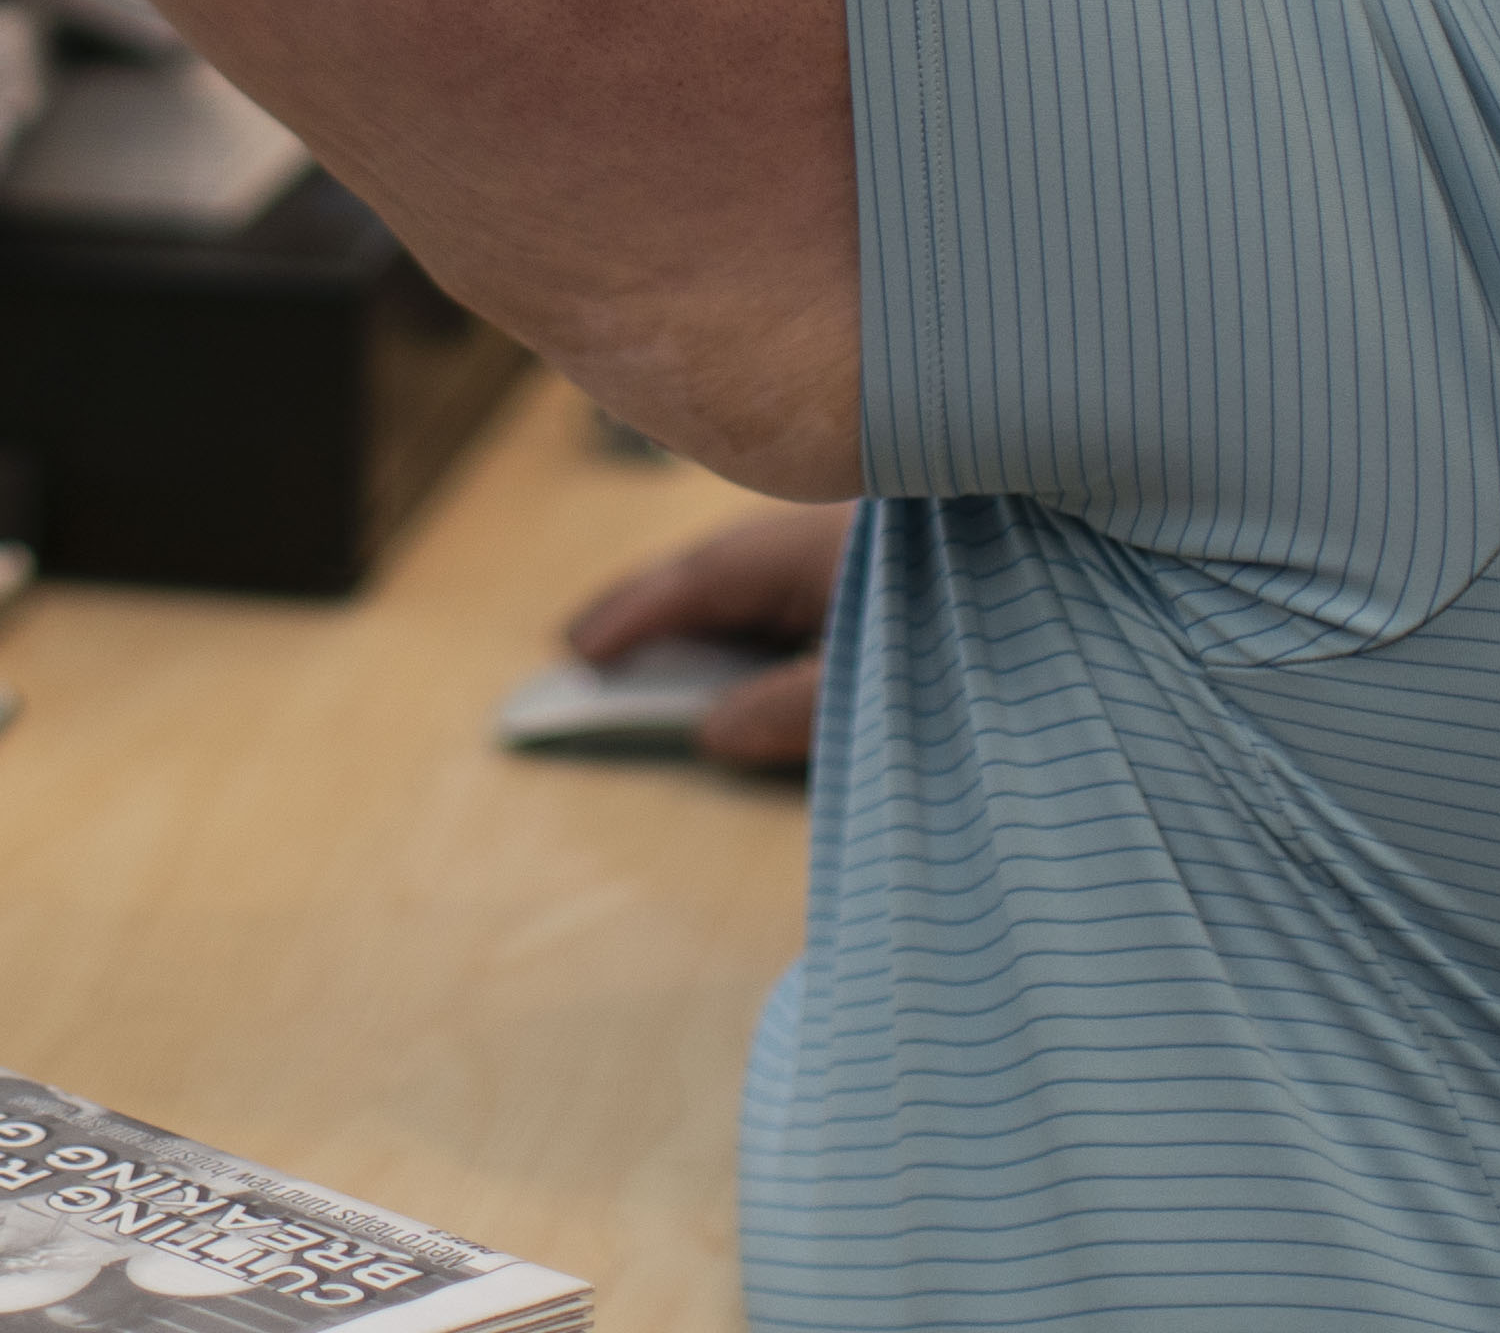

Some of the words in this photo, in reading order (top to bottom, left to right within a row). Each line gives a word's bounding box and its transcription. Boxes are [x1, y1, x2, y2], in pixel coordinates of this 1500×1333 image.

[227, 1168, 279, 1200] new
[43, 1144, 423, 1289] BREAKING
[284, 1186, 341, 1226] fund
[340, 1202, 402, 1246] helps
[44, 1183, 365, 1306] CUTTING
[393, 1231, 474, 1269] Metro
